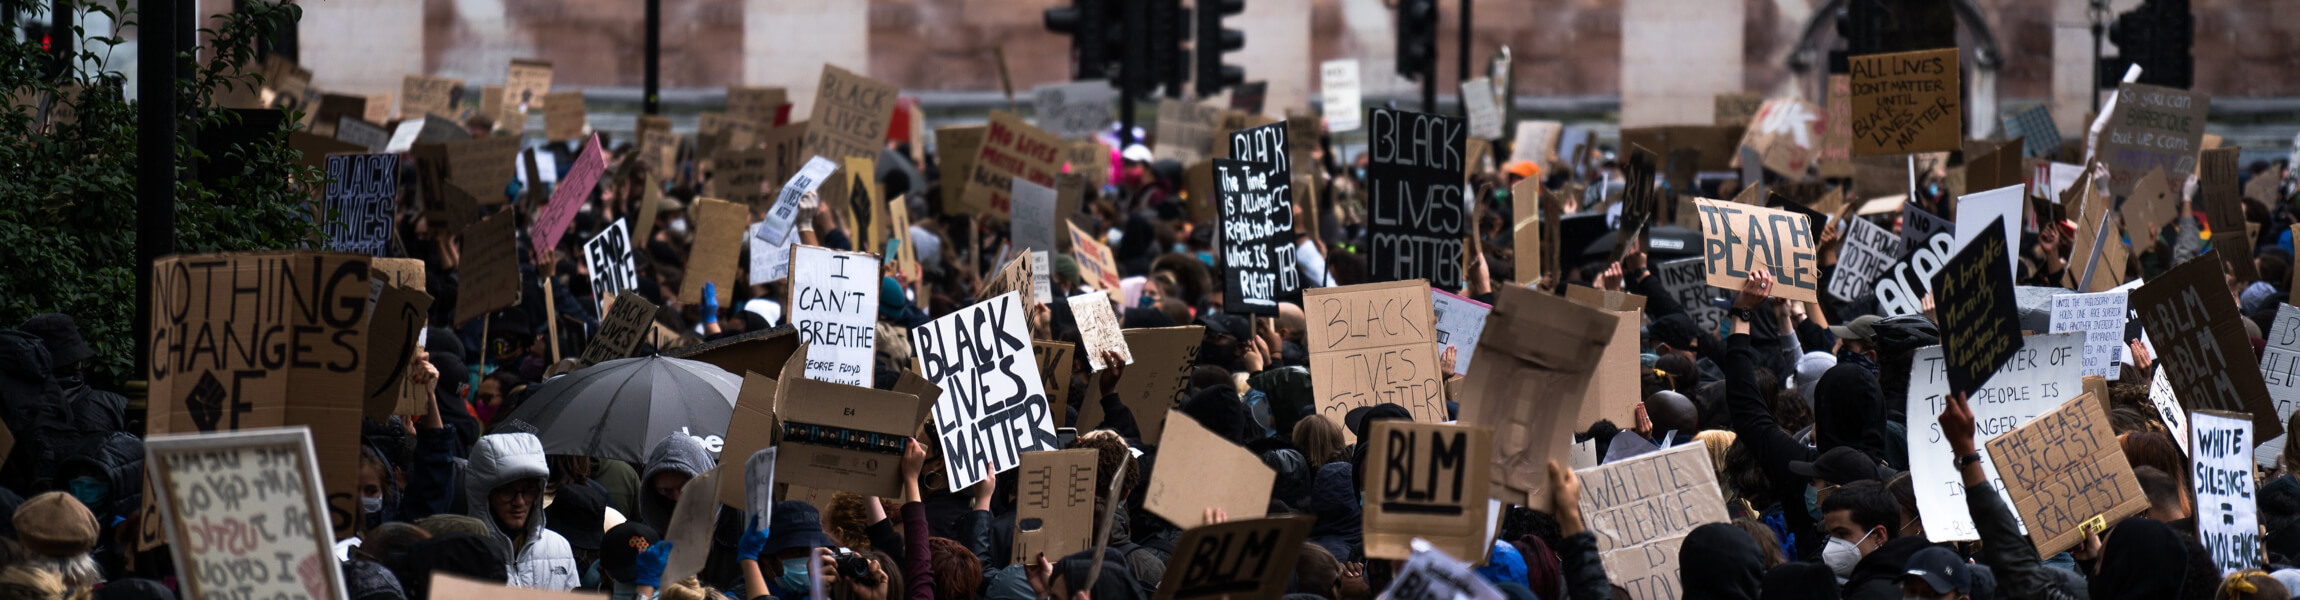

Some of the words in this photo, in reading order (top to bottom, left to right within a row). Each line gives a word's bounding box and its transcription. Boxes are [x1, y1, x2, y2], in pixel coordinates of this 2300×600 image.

[1852, 57, 1888, 79] ALL
[1892, 56, 1944, 76] LIVES
[822, 73, 889, 112] BLACK
[1876, 93, 1918, 107] UNTIL
[1890, 79, 1945, 92] MATTER
[2120, 88, 2136, 104] So
[2140, 90, 2164, 107] you
[2167, 94, 2192, 109] can
[823, 105, 880, 139] LIVES
[1852, 104, 1897, 139] BLACK
[1871, 108, 1914, 148] LIVES
[1896, 96, 1956, 151] MATTER
[2111, 129, 2133, 145] but
[2137, 133, 2154, 147] we
[1015, 132, 1060, 165] LIVES
[1374, 109, 1462, 173] BLACK
[325, 154, 398, 198] BLACK
[1218, 166, 1240, 192] The
[1241, 165, 1268, 191] Time
[322, 194, 394, 243] LIVES
[1224, 193, 1236, 217] is
[1375, 178, 1462, 234] LIVES
[1909, 210, 1931, 234] NO
[1252, 220, 1264, 240] to
[1264, 217, 1276, 237] do
[1699, 204, 1812, 285] TEACH
[1849, 218, 1871, 246] ALL
[589, 223, 625, 276] END
[1226, 244, 1254, 268] What
[1371, 232, 1464, 287] MATTER
[1705, 208, 1816, 290] PEACE
[1842, 241, 1860, 269] TO
[1858, 249, 1888, 279] THE
[830, 255, 850, 280] I
[1663, 262, 1706, 287] INSID
[1832, 267, 1874, 301] PEOP
[152, 255, 369, 330] NOTHING
[799, 286, 866, 315] CAN'T
[1240, 270, 1276, 300] RIGHT
[1941, 272, 1955, 303] A
[611, 295, 649, 327] BLACK
[2056, 298, 2071, 308] UNTIL
[2072, 298, 2081, 307] THE
[2059, 309, 2074, 320] HOLDS
[2076, 309, 2086, 319] ONE
[2090, 308, 2101, 318] RACE
[2102, 306, 2122, 318] SUPERIOR
[2145, 284, 2211, 348] #BLM
[600, 318, 636, 349] LIVES
[799, 319, 875, 349] BREATHE
[917, 296, 1025, 385] BLACK
[1322, 298, 1424, 349] BLACK
[2055, 321, 2067, 331] AND
[2069, 320, 2092, 331] ANOTHER
[2093, 320, 2114, 330] INFERIOR
[2115, 319, 2122, 329] IS
[2090, 331, 2121, 342] PERMANENTLY
[151, 320, 360, 382] CHANGES
[2050, 346, 2073, 367] OF
[2095, 344, 2107, 354] AND
[2165, 324, 2228, 392] #BLM
[838, 362, 861, 377] FLOYD
[1330, 348, 1417, 402] LIVES
[935, 354, 1028, 436] LIVES
[1357, 377, 1449, 422] TER!
[1978, 385, 2031, 406] PEOPLE
[2041, 382, 2060, 399] IS
[843, 407, 856, 417] E4
[943, 393, 1060, 490] MATTER
[1994, 429, 2037, 465] THE
[2034, 399, 2090, 446] LEAST
[2197, 427, 2244, 459] WHITE
[1383, 428, 1468, 503] BLM
[2011, 423, 2100, 490] RACIST
[1580, 452, 1689, 511] WHITE
[2026, 480, 2055, 513] IS
[2055, 455, 2110, 498] STILL
[2196, 461, 2251, 500] SILENCE
[1591, 488, 1700, 554] SILENCE
[2035, 472, 2124, 541] RACIST
[1182, 528, 1282, 588] BLM
[1642, 542, 1666, 569] IS
[2203, 529, 2263, 573] VIOLENCE
